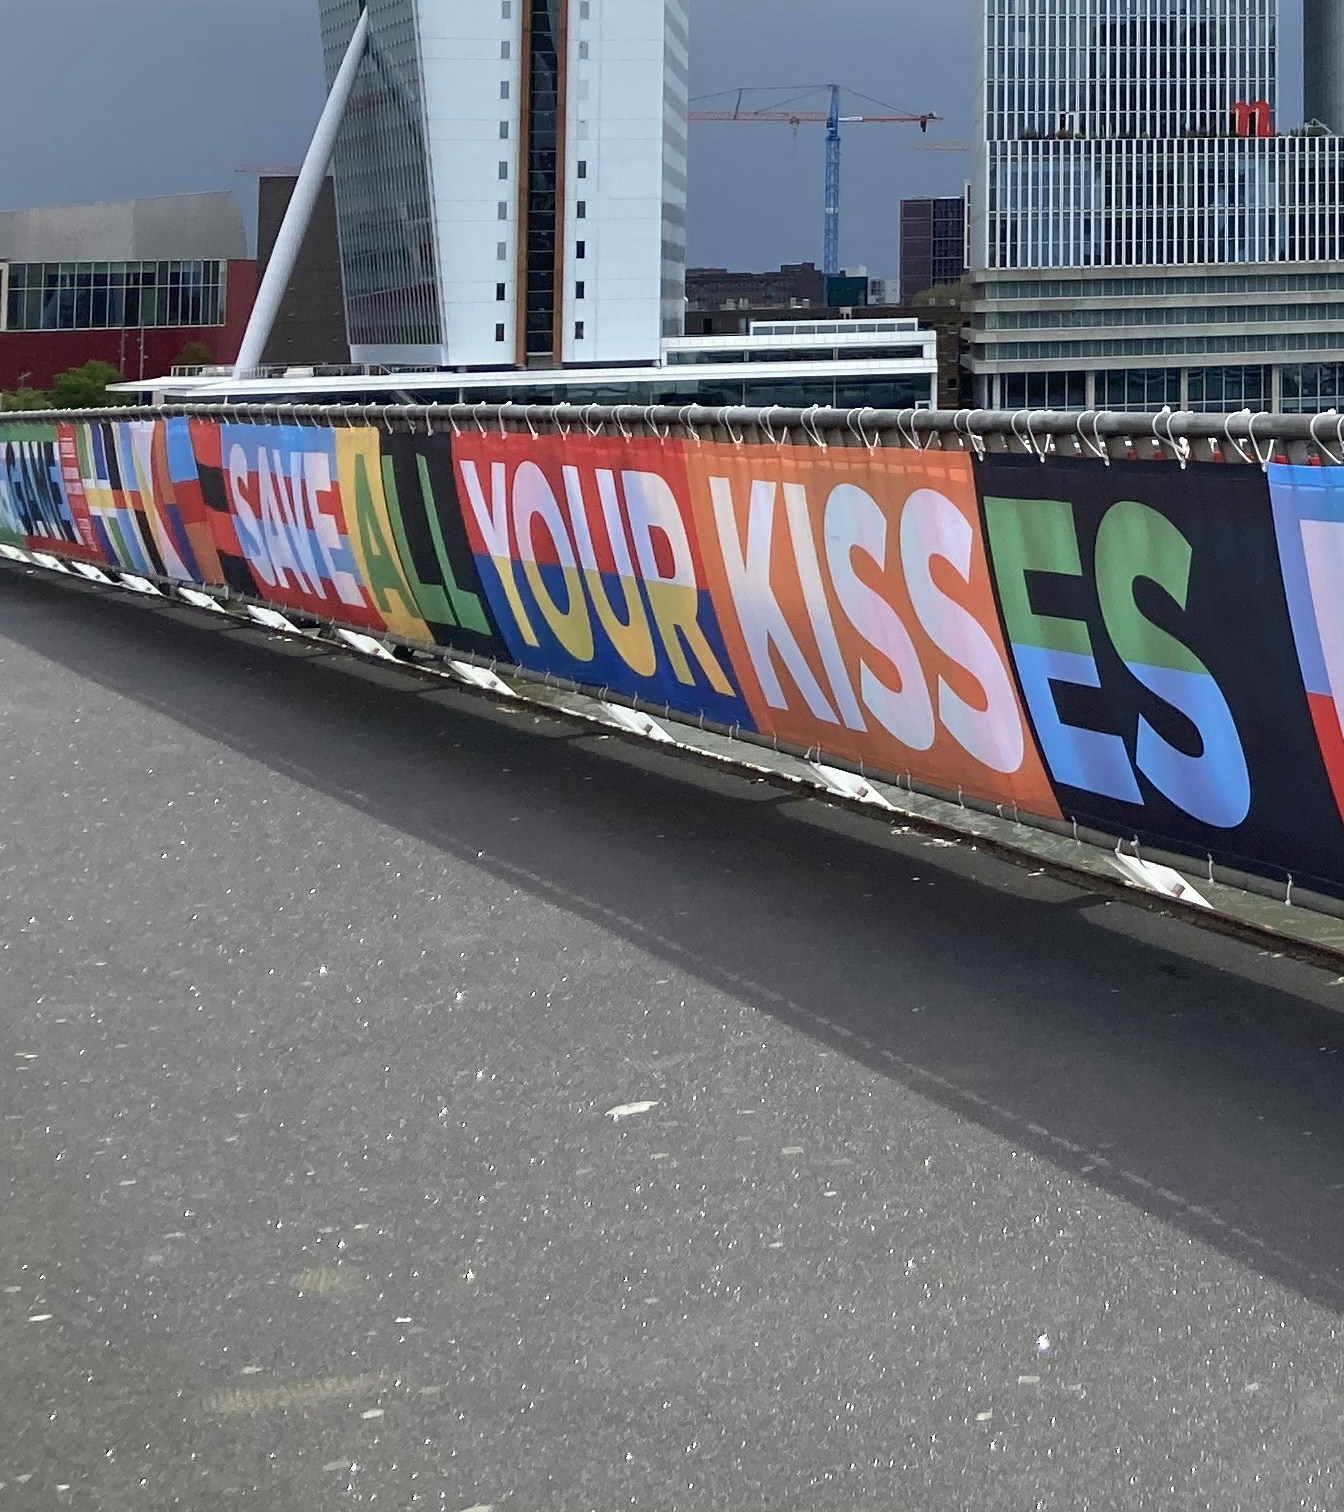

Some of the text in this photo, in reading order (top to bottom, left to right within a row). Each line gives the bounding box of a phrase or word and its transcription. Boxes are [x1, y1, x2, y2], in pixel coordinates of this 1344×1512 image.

[228, 443, 368, 609] SAVE
[354, 452, 492, 636] ALL
[460, 458, 737, 697] YOUR
